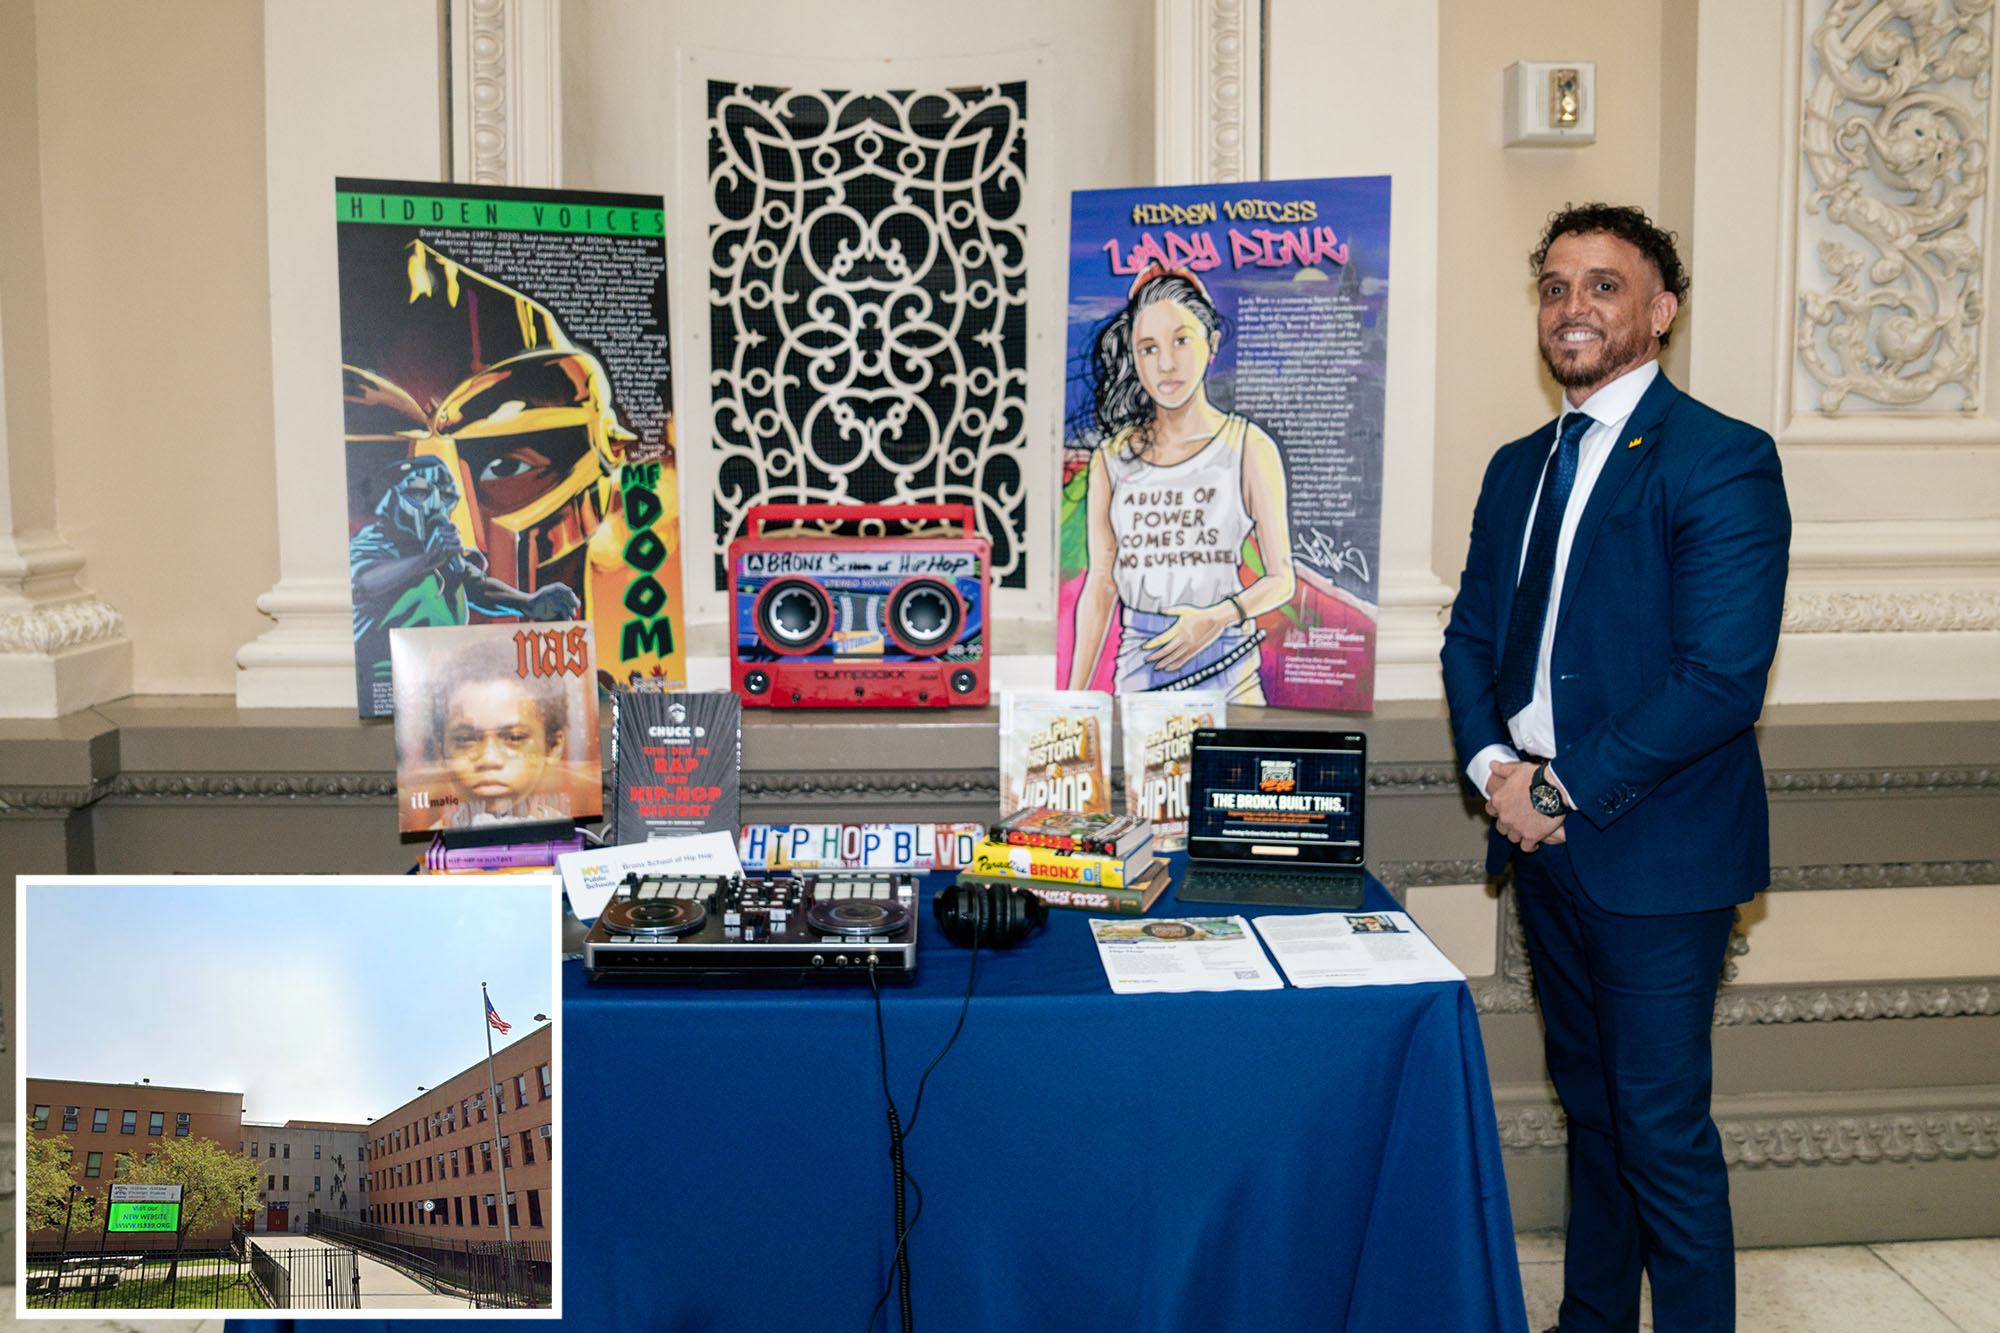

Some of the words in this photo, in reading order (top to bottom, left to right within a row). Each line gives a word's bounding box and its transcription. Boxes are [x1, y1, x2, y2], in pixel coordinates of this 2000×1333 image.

[351, 196, 498, 226] HIDDEN
[534, 206, 665, 234] VOICES
[1132, 200, 1217, 224] HIDDEN
[1222, 200, 1318, 223] VOICES
[1102, 229, 1222, 275] LADY
[621, 462, 662, 489] MF
[1124, 489, 1184, 506] ABUSE
[1193, 487, 1217, 504] OF
[1132, 510, 1206, 530] POWER
[1120, 530, 1186, 548] COMES
[1195, 528, 1220, 546] AS
[766, 553, 824, 572] BRONX
[1119, 552, 1140, 570] NO
[1144, 550, 1236, 567] SURPRISE
[620, 484, 674, 662] DOOM
[824, 578, 860, 588] STEREO
[862, 578, 896, 588] SOUND
[514, 626, 590, 679] nas
[648, 726, 691, 738] CHUCK
[694, 726, 706, 738] D
[643, 746, 667, 756] THIS
[671, 746, 692, 756] DAY
[696, 746, 709, 756] IN
[654, 758, 699, 773] RAP
[664, 776, 688, 784] AND
[630, 786, 722, 802] HIP-HOP
[1212, 793, 1236, 808] THE
[1236, 794, 1278, 809] BRONX
[1278, 796, 1312, 810] BUILT
[1311, 796, 1345, 812] THIS.
[640, 804, 712, 817] HISTORY
[748, 828, 809, 865] HIP
[822, 824, 880, 866] HOP
[895, 825, 974, 866] BLVD
[580, 864, 609, 876] NYC
[622, 862, 645, 870] Bronx
[647, 857, 674, 866] School
[684, 855, 696, 864] Hip
[1030, 863, 1080, 880] BRONX
[583, 876, 607, 884] Public
[586, 880, 616, 890] Schools
